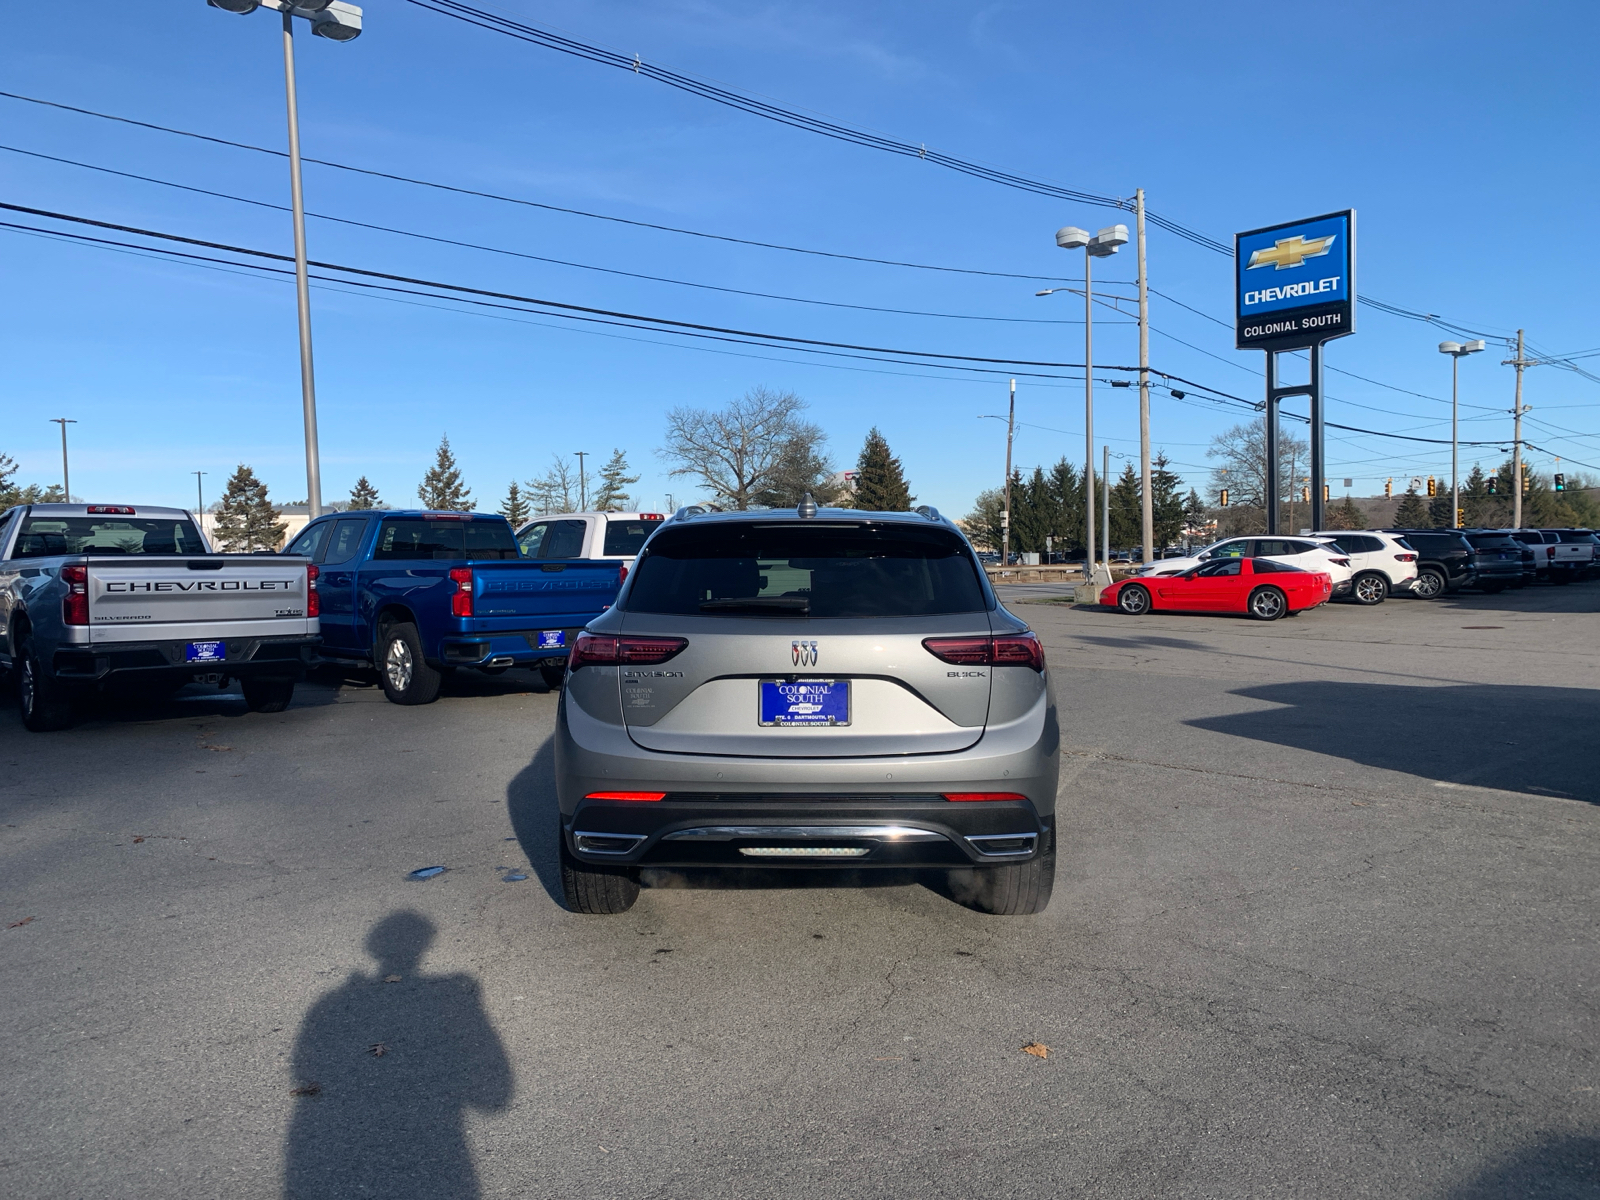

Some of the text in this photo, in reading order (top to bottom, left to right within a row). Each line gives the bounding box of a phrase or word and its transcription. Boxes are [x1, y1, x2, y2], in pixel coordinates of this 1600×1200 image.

[1244, 276, 1340, 305] CHEVROLET
[1244, 313, 1341, 337] COLONIAL SOUTH
[106, 580, 295, 592] CHEVROLET
[779, 685, 831, 695] COLONIAL
[787, 694, 823, 703] SOUTH
